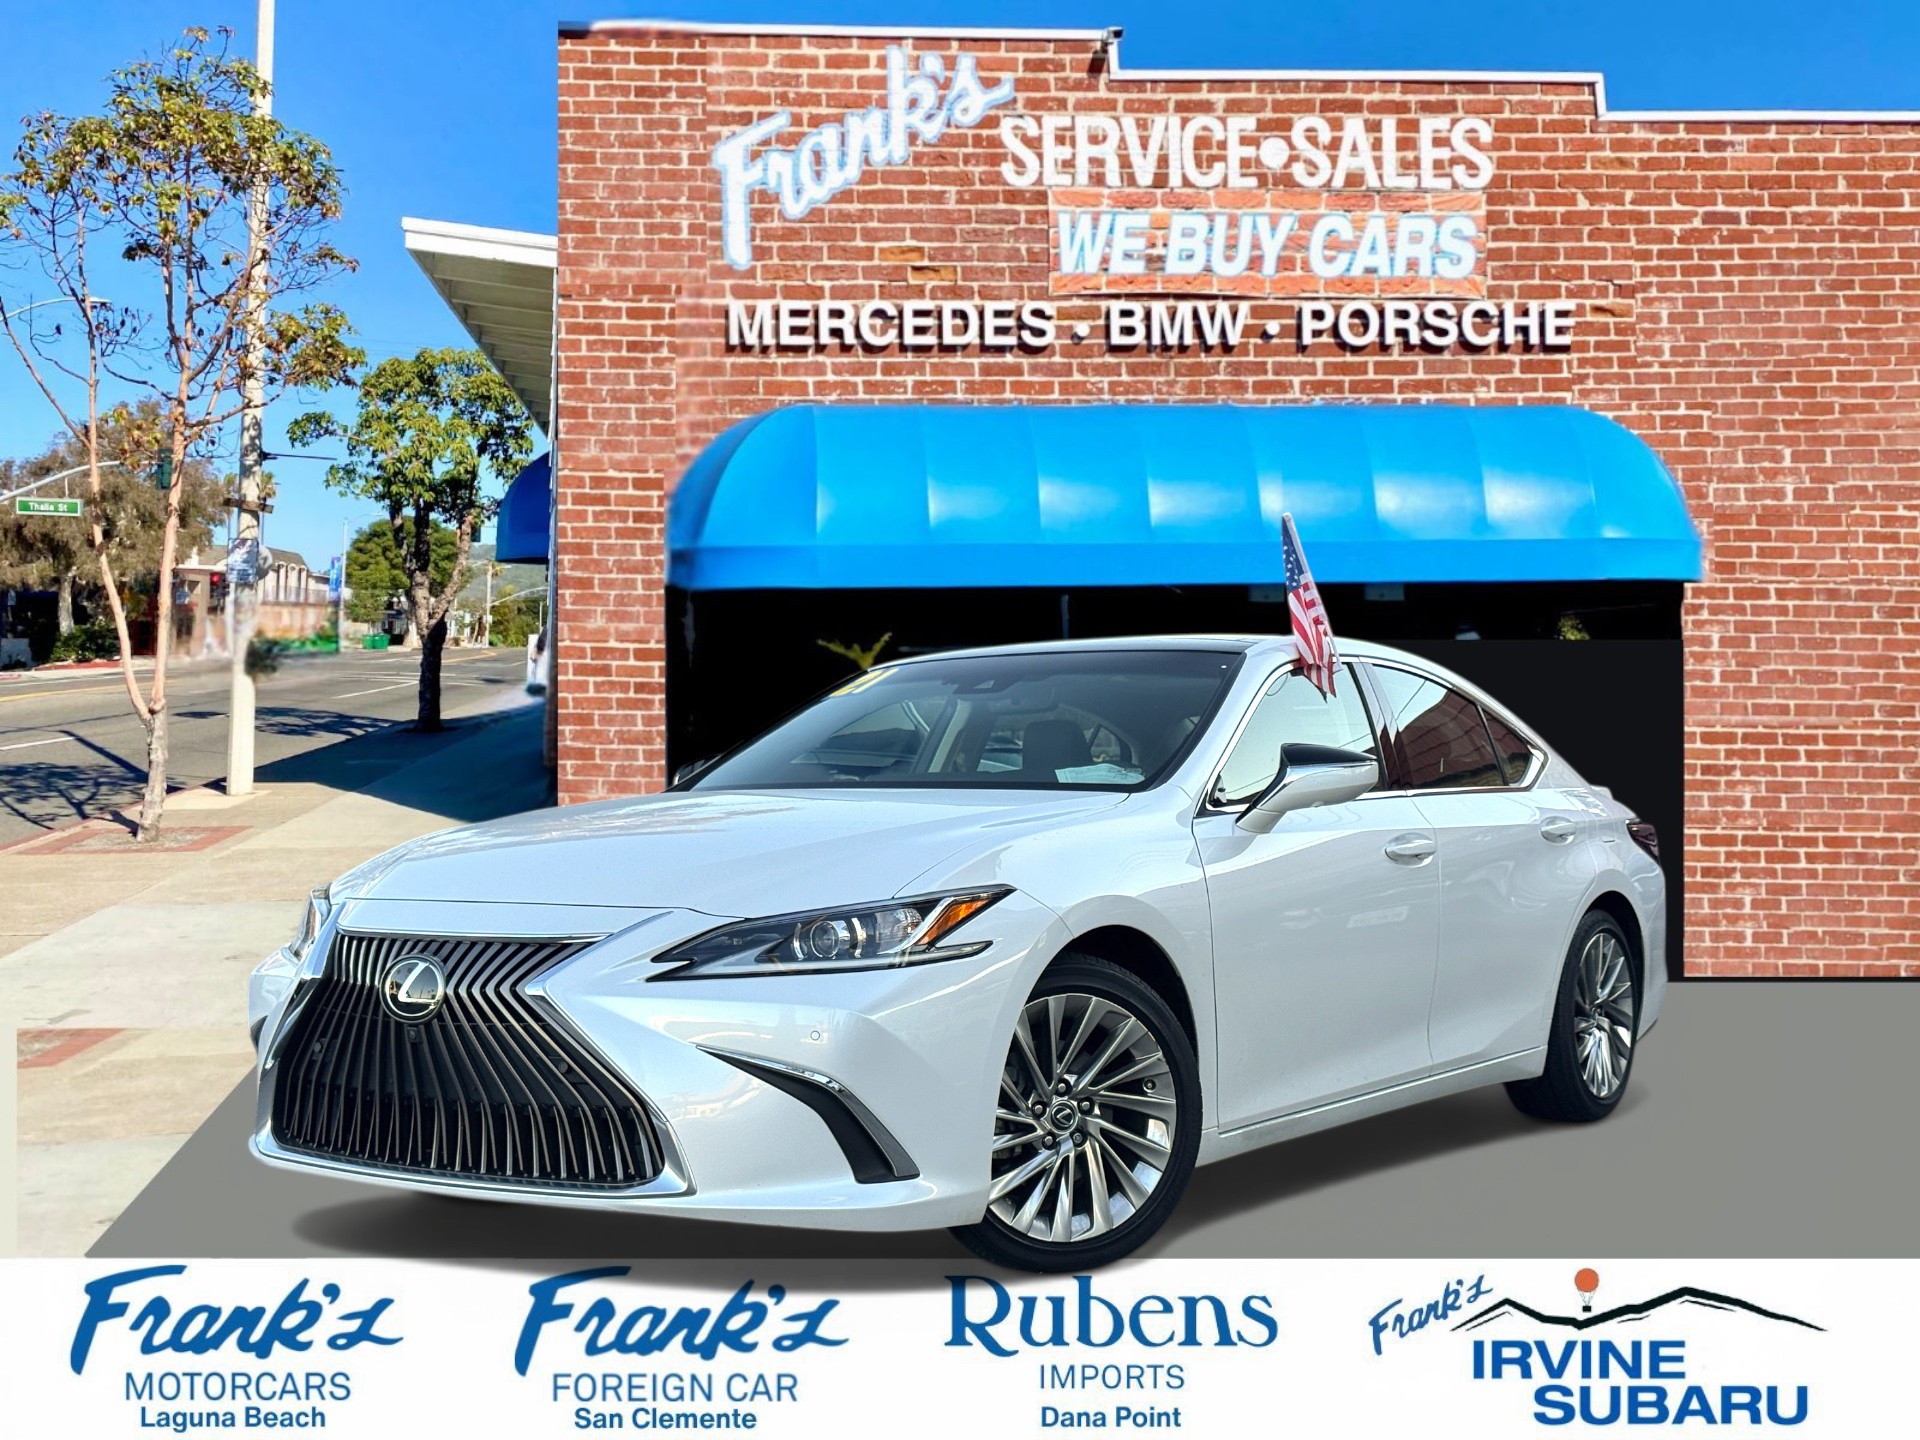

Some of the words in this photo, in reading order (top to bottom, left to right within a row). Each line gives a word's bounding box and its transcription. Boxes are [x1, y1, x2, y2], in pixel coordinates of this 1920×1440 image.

[713, 45, 1015, 270] Frank's
[1000, 116, 1257, 187] SERVICE
[1291, 117, 1494, 189] SALES
[1056, 210, 1152, 275] WE
[1164, 211, 1297, 276] BUY
[1308, 213, 1479, 280] CARS
[727, 300, 1057, 347] MERCEDES
[1107, 300, 1249, 346] BMW
[1300, 300, 1577, 347] PORSCHE
[57, 503, 68, 512] St
